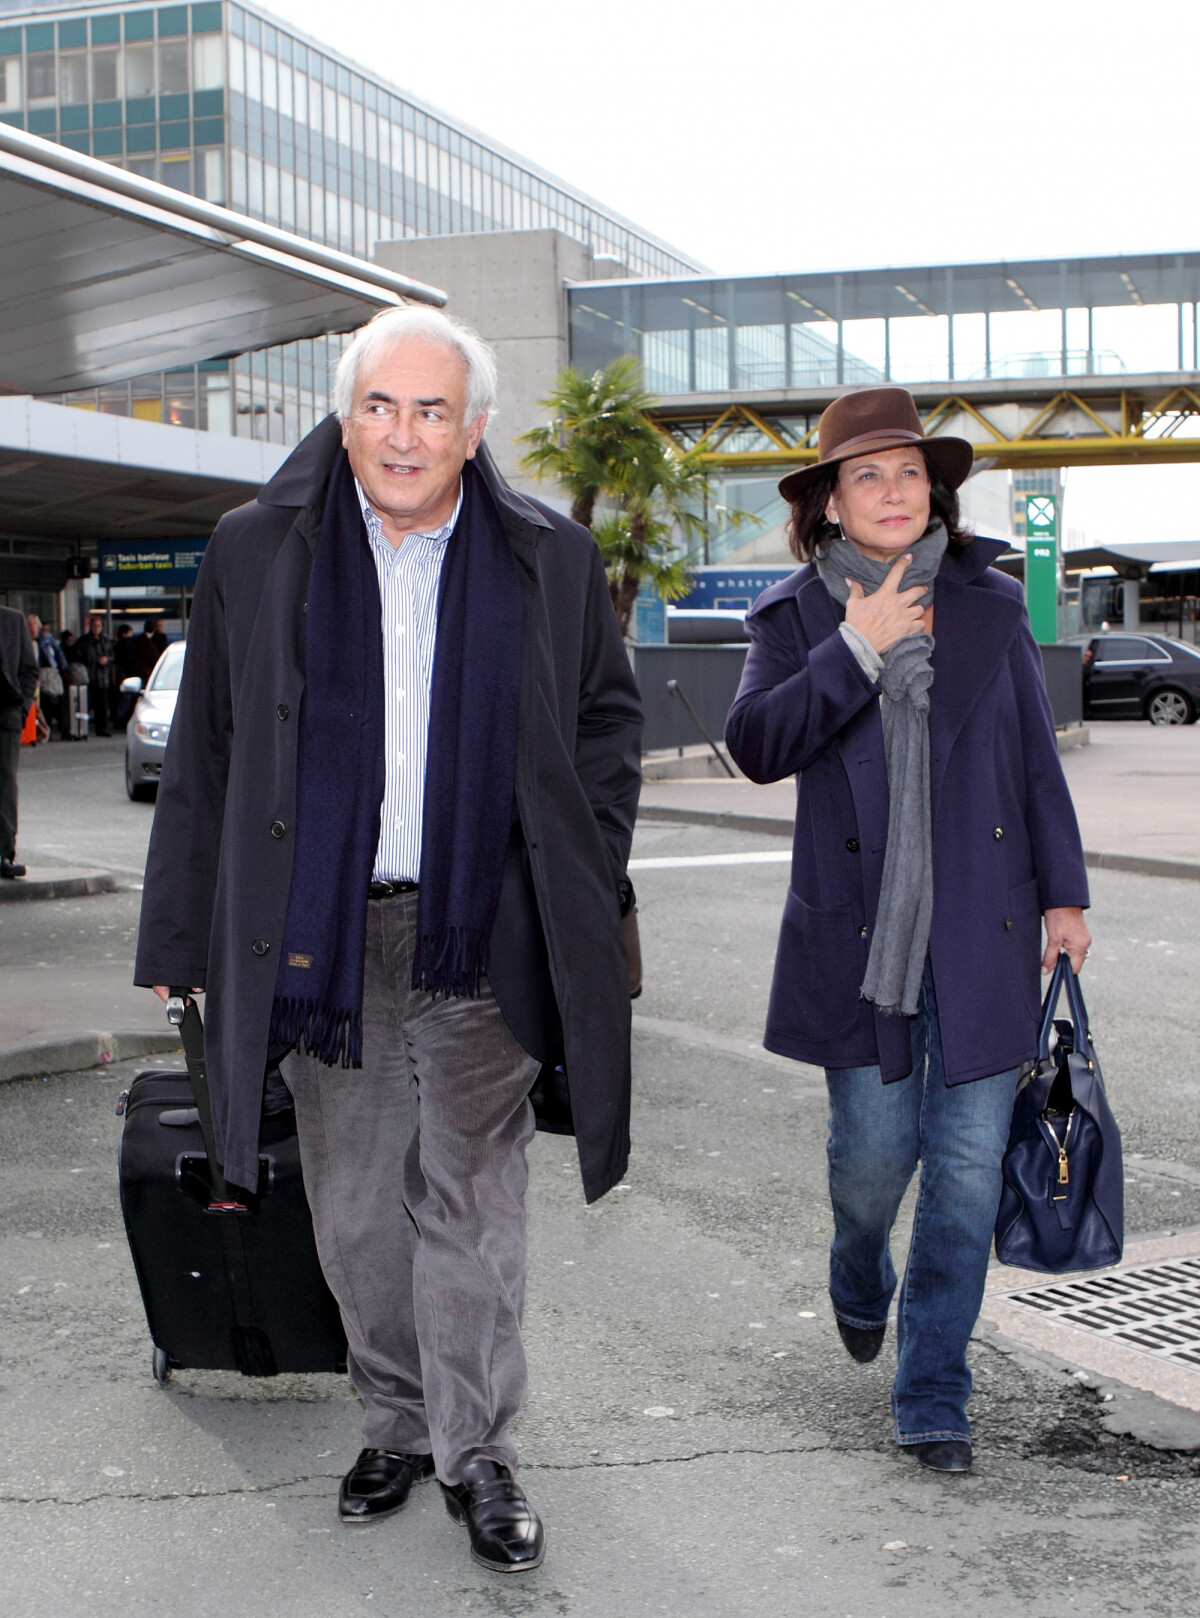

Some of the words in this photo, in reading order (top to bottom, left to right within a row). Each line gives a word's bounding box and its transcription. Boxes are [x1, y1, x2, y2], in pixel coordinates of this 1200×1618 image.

[118, 553, 136, 562] Taxis
[137, 552, 170, 562] banlieue
[118, 562, 153, 571] Suburban
[154, 562, 173, 570] taxis
